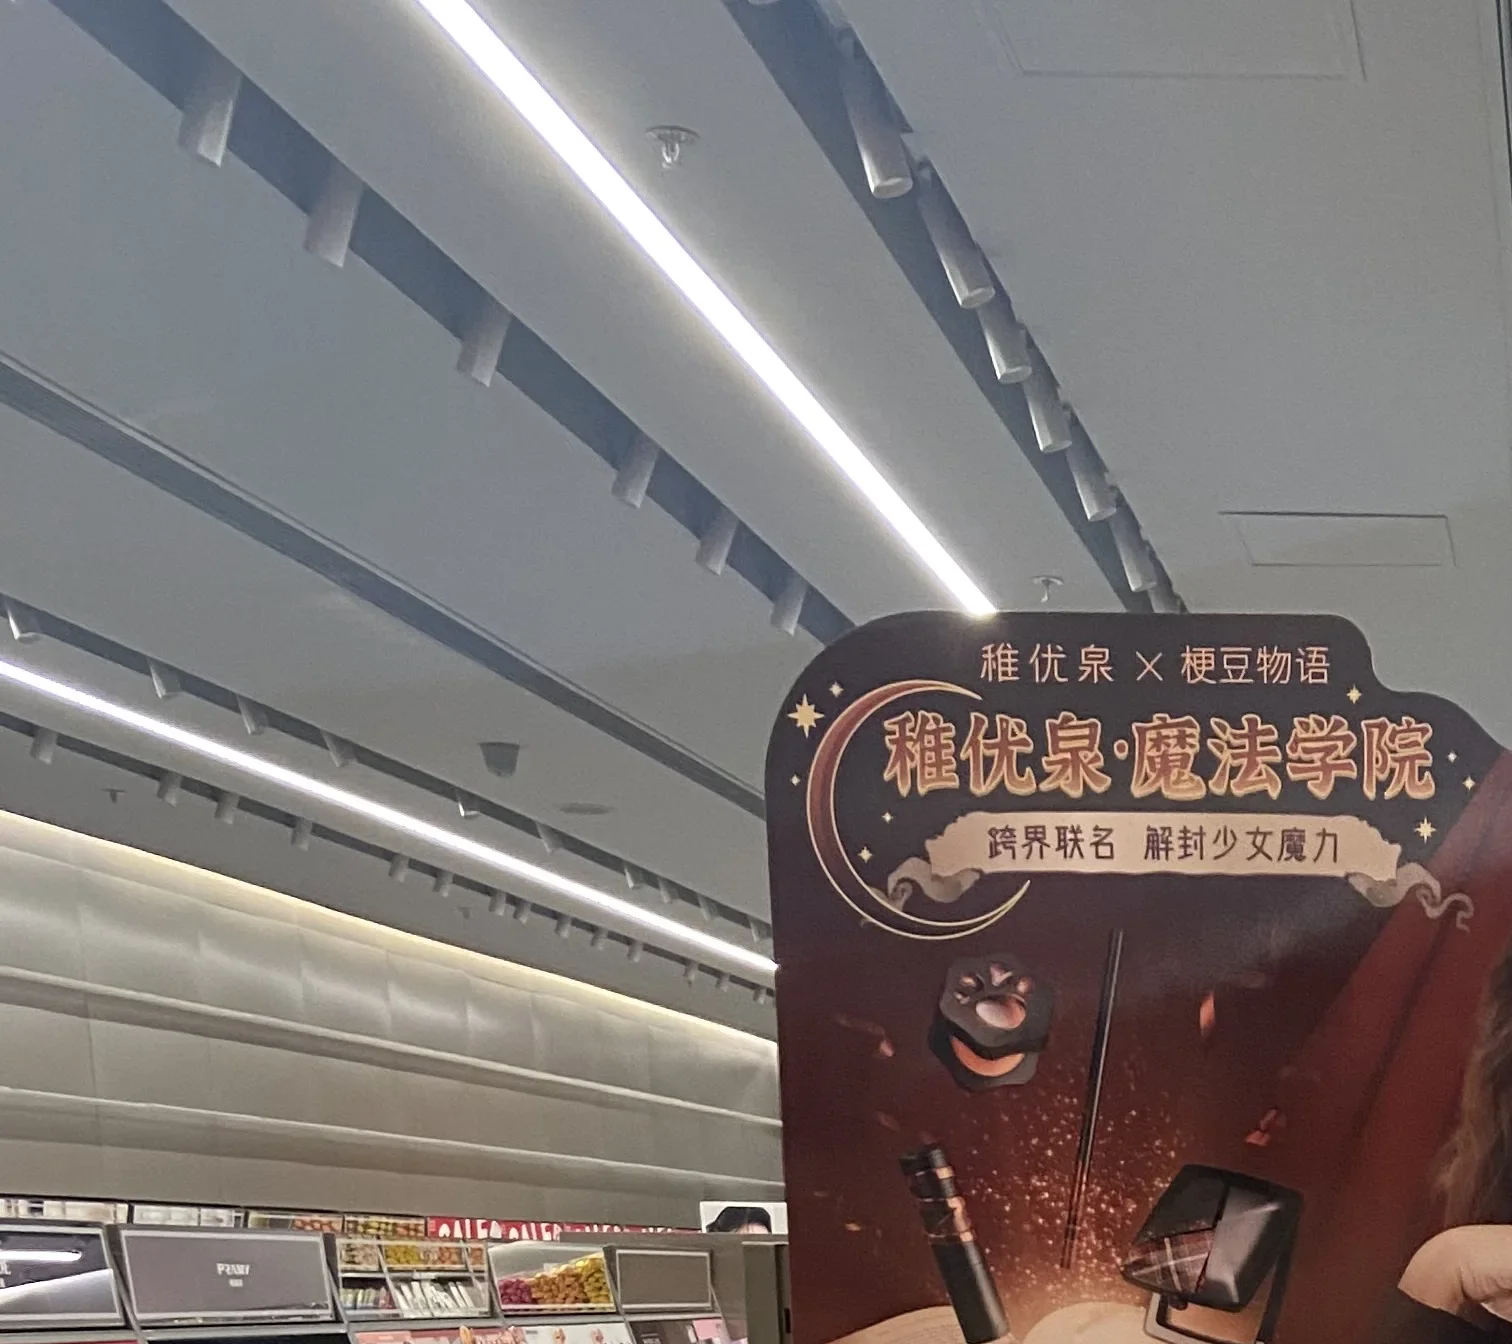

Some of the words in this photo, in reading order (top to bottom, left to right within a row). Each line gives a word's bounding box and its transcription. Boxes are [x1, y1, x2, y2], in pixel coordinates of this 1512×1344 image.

[980, 642, 1115, 684] 稚优泉
[1180, 643, 1331, 686] 梗豆物语
[987, 824, 1117, 862] 跨界联名
[1143, 824, 1340, 863] 解封少女魔力
